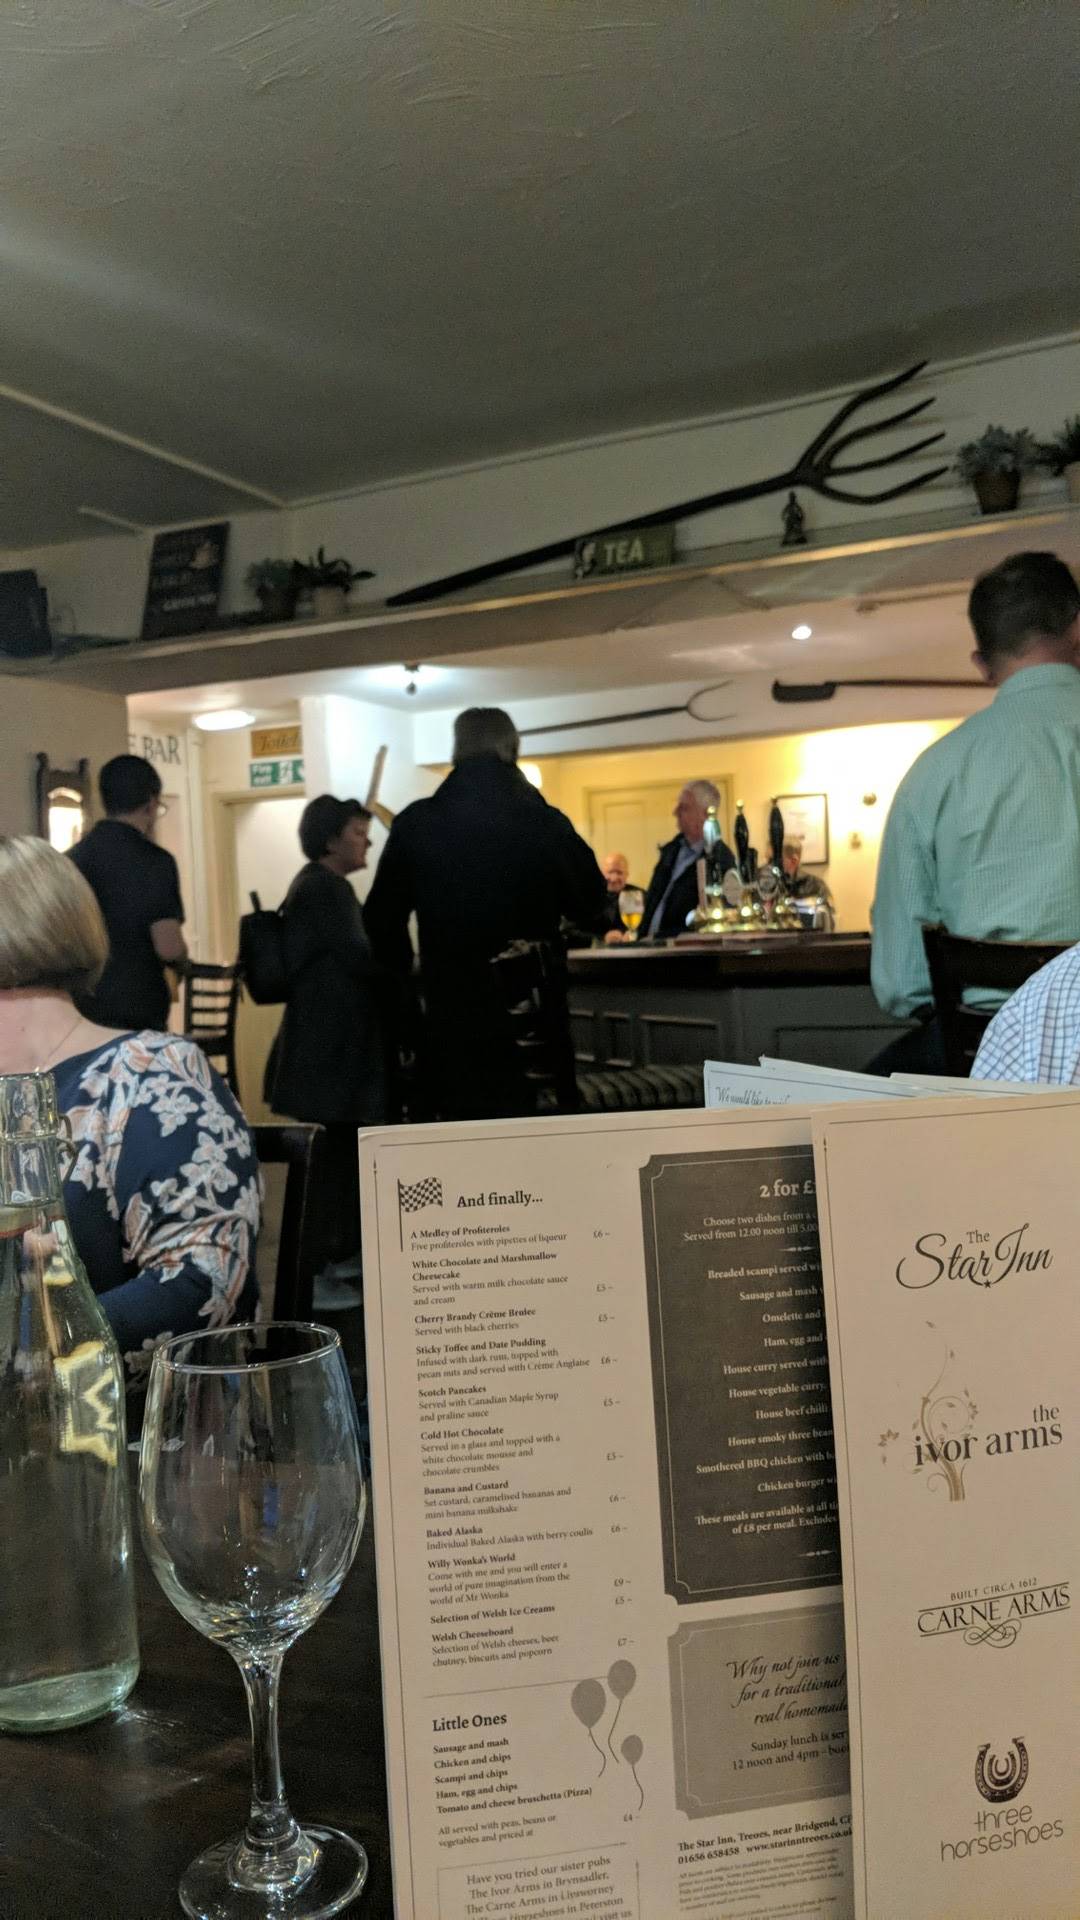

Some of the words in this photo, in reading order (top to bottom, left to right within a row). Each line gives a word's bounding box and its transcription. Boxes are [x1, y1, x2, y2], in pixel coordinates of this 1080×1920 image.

[604, 536, 643, 566] TEA
[142, 735, 181, 765] BAR
[759, 1185, 770, 1198] 2
[773, 1178, 800, 1197] for
[457, 1193, 485, 1208] And
[410, 1230, 418, 1239] A
[419, 1228, 449, 1239] Medley
[451, 1226, 460, 1236] of
[462, 1224, 510, 1236] Profiteroles
[966, 1230, 990, 1244] The
[412, 1258, 438, 1269] White
[439, 1256, 481, 1267] Chocolate
[482, 1254, 499, 1264] and
[500, 1251, 556, 1263] Marshmallow
[896, 1233, 992, 1289] Star
[994, 1223, 1053, 1285] Inn
[412, 1270, 460, 1281] Cheesecake
[708, 1267, 744, 1279] Breaded
[746, 1264, 778, 1277] scampi
[779, 1262, 808, 1273] served
[739, 1289, 774, 1301] Sausage
[776, 1287, 793, 1298] and
[794, 1285, 817, 1296] mash
[414, 1313, 444, 1325] Cherry
[446, 1311, 476, 1322] Brandy
[762, 1311, 803, 1322] Omelette
[804, 1309, 822, 1319] and
[416, 1344, 441, 1356] Sticky
[444, 1342, 468, 1353] Toffee
[470, 1340, 486, 1351] and
[488, 1339, 508, 1349] Date
[510, 1337, 546, 1348] Pudding
[723, 1364, 752, 1374] House
[753, 1363, 778, 1372] curry
[779, 1358, 808, 1370] served
[418, 1386, 446, 1397] Scotch
[448, 1384, 486, 1395] Pancakes
[755, 1408, 784, 1419] House
[785, 1406, 804, 1417] beef
[1032, 1404, 1060, 1423] the
[420, 1429, 441, 1440] Cold
[443, 1428, 459, 1438] Hot
[461, 1425, 504, 1437] Chocolate
[728, 1435, 756, 1446] House
[757, 1432, 786, 1443] smoky
[788, 1430, 811, 1440] three
[914, 1434, 978, 1466] ivor
[986, 1422, 1063, 1456] arms
[696, 1459, 745, 1474] Smothered
[746, 1457, 768, 1469] BBQ
[769, 1454, 803, 1466] chicken
[423, 1484, 455, 1495] Banana
[456, 1482, 474, 1492] and
[475, 1479, 509, 1491] Custard
[757, 1480, 794, 1492] Chicken
[795, 1477, 824, 1489] burger
[426, 1526, 453, 1538] Baked
[454, 1525, 483, 1536] Alaska
[428, 1558, 450, 1569] Willy
[489, 1551, 516, 1563] World
[950, 1588, 979, 1601] BUILT
[983, 1581, 1015, 1595] CIRCA
[1018, 1577, 1038, 1589] 1612
[430, 1612, 469, 1624] Selection
[470, 1610, 480, 1620] of
[482, 1607, 507, 1619] Welsh
[509, 1606, 522, 1616] Ice
[522, 1604, 555, 1615] Creams
[917, 1600, 1001, 1633] CARNE
[1007, 1585, 1071, 1617] ARMS
[432, 1630, 457, 1642] Welsh
[458, 1625, 514, 1640] Cheeseboard
[726, 1656, 767, 1683] Why
[772, 1656, 793, 1672] not
[731, 1681, 760, 1708] for
[761, 1687, 770, 1699] a
[433, 1716, 469, 1732] Little
[472, 1712, 508, 1728] Ones
[754, 1702, 782, 1725] real
[433, 1742, 466, 1754] Sausage
[468, 1739, 484, 1750] and
[486, 1736, 509, 1748] mash
[750, 1738, 788, 1752] Sunday
[790, 1732, 819, 1746] lunch
[820, 1731, 830, 1742] is
[434, 1757, 469, 1769] Chicken
[470, 1754, 487, 1765] and
[488, 1752, 511, 1764] chips
[733, 1759, 746, 1770] 12
[746, 1757, 773, 1768] noon
[775, 1751, 794, 1764] and
[796, 1748, 820, 1762] 4pm
[434, 1771, 466, 1784] Scampi
[468, 1769, 484, 1780] and
[485, 1768, 508, 1779] chips
[461, 1788, 476, 1798] egg
[477, 1783, 494, 1795] and
[495, 1782, 518, 1793] chips
[436, 1802, 469, 1814] Tomato
[470, 1798, 487, 1810] and
[488, 1796, 516, 1808] cheese
[517, 1791, 562, 1804] bruschetta
[563, 1786, 592, 1801] (Pizza)
[974, 1805, 1032, 1832] three
[679, 1840, 694, 1851] The
[696, 1837, 715, 1849] Star
[772, 1826, 792, 1836] near
[940, 1819, 1064, 1861] horseshoes
[678, 1850, 705, 1865] 01656
[466, 1873, 492, 1885] Have
[494, 1871, 512, 1884] you
[514, 1865, 538, 1878] tried
[540, 1864, 558, 1874] our
[560, 1859, 586, 1872] sister
[587, 1856, 611, 1870] pubs
[470, 1888, 488, 1899] The
[490, 1884, 511, 1896] Ivor
[513, 1880, 541, 1893] Arms
